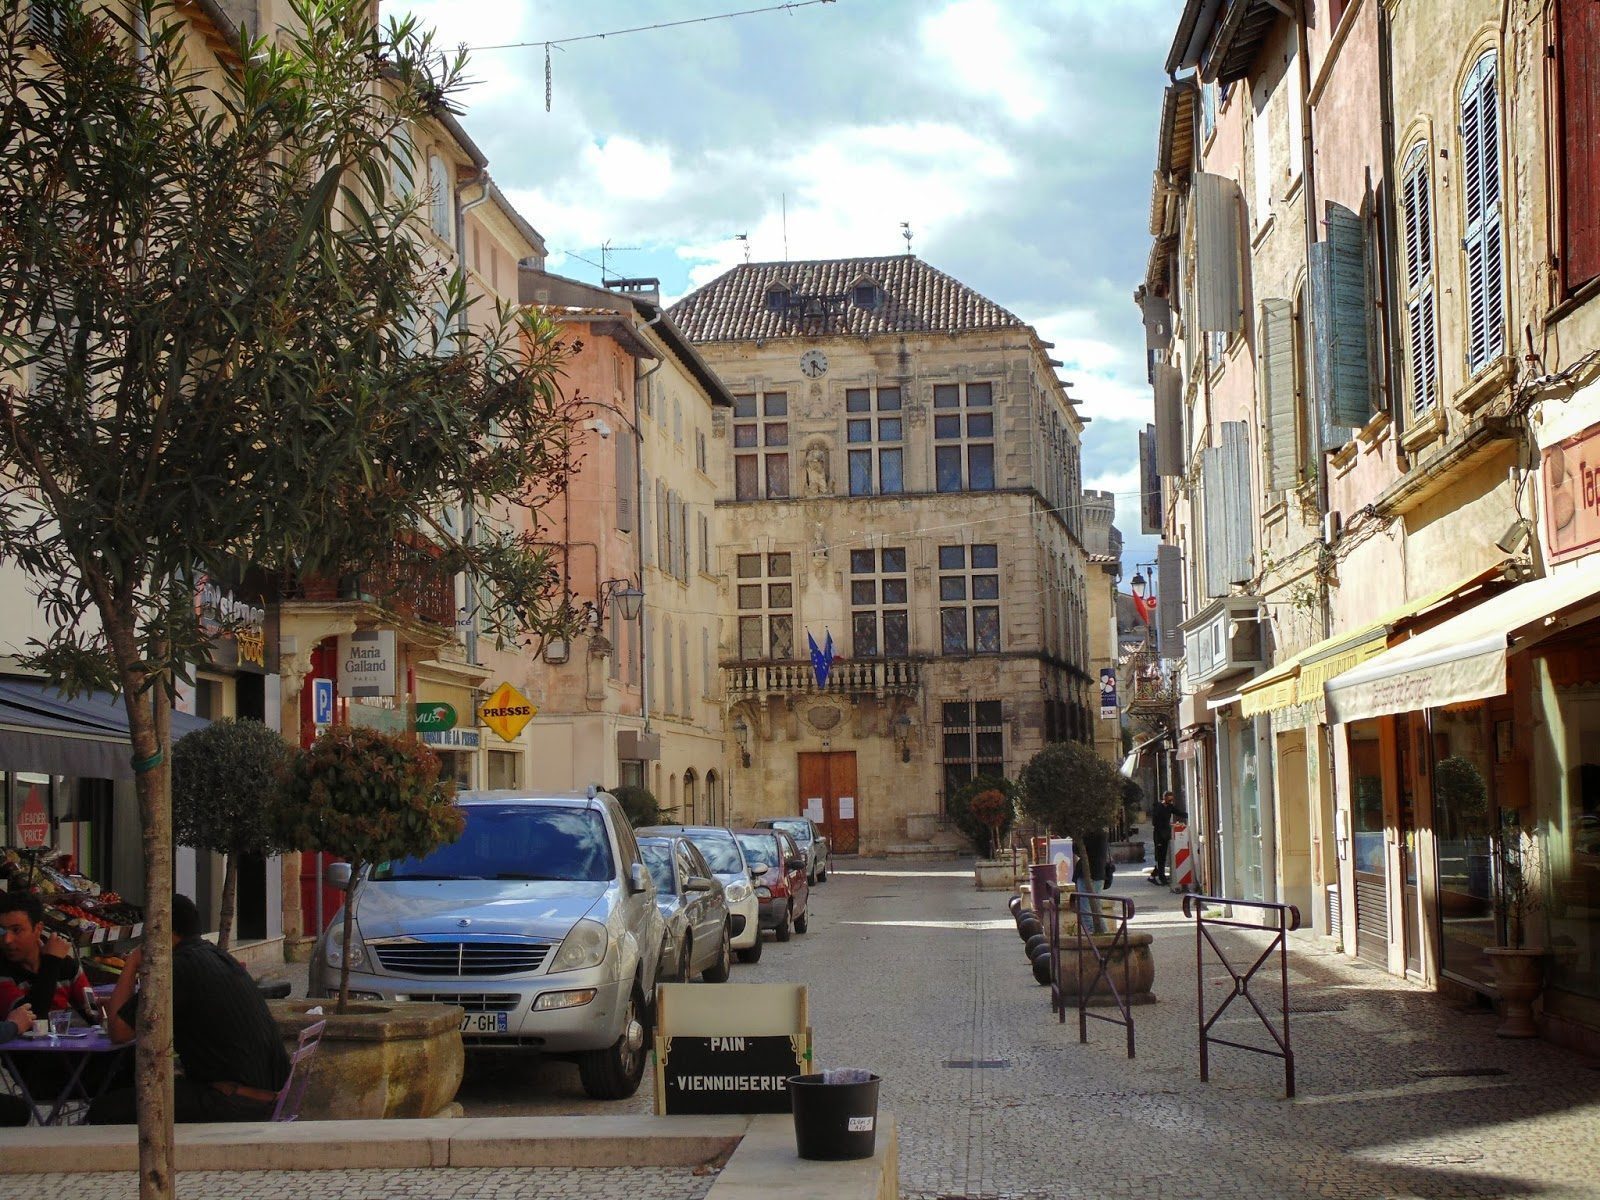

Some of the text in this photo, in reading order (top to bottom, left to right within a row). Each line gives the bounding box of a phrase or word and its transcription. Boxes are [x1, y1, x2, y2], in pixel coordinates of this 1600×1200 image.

[350, 646, 381, 659] Maria
[345, 660, 386, 673] Galland
[320, 689, 328, 717] P
[483, 706, 530, 717] PRESSE
[21, 812, 46, 824] LEADER
[24, 829, 43, 841] PRICE
[711, 1037, 745, 1052] PAIN
[677, 1075, 787, 1091] VIENNOISERIE
